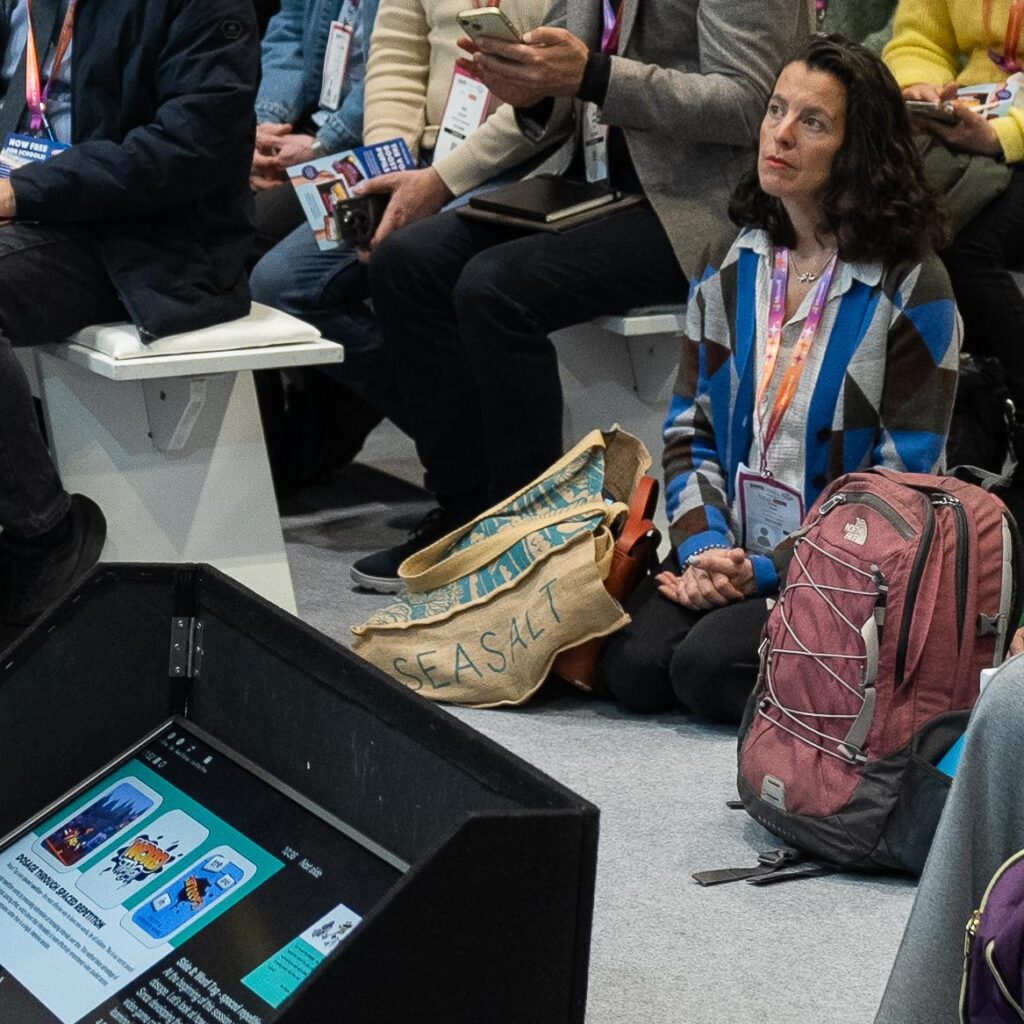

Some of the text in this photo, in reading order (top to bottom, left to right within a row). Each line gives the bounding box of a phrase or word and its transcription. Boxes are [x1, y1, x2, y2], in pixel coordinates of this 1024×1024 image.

[9, 138, 48, 153] NOW FREE
[393, 578, 561, 690] SEASALT
[120, 837, 171, 871] WORD
[16, 854, 104, 928] DOSAGE THROUGH SPACED REPETITION
